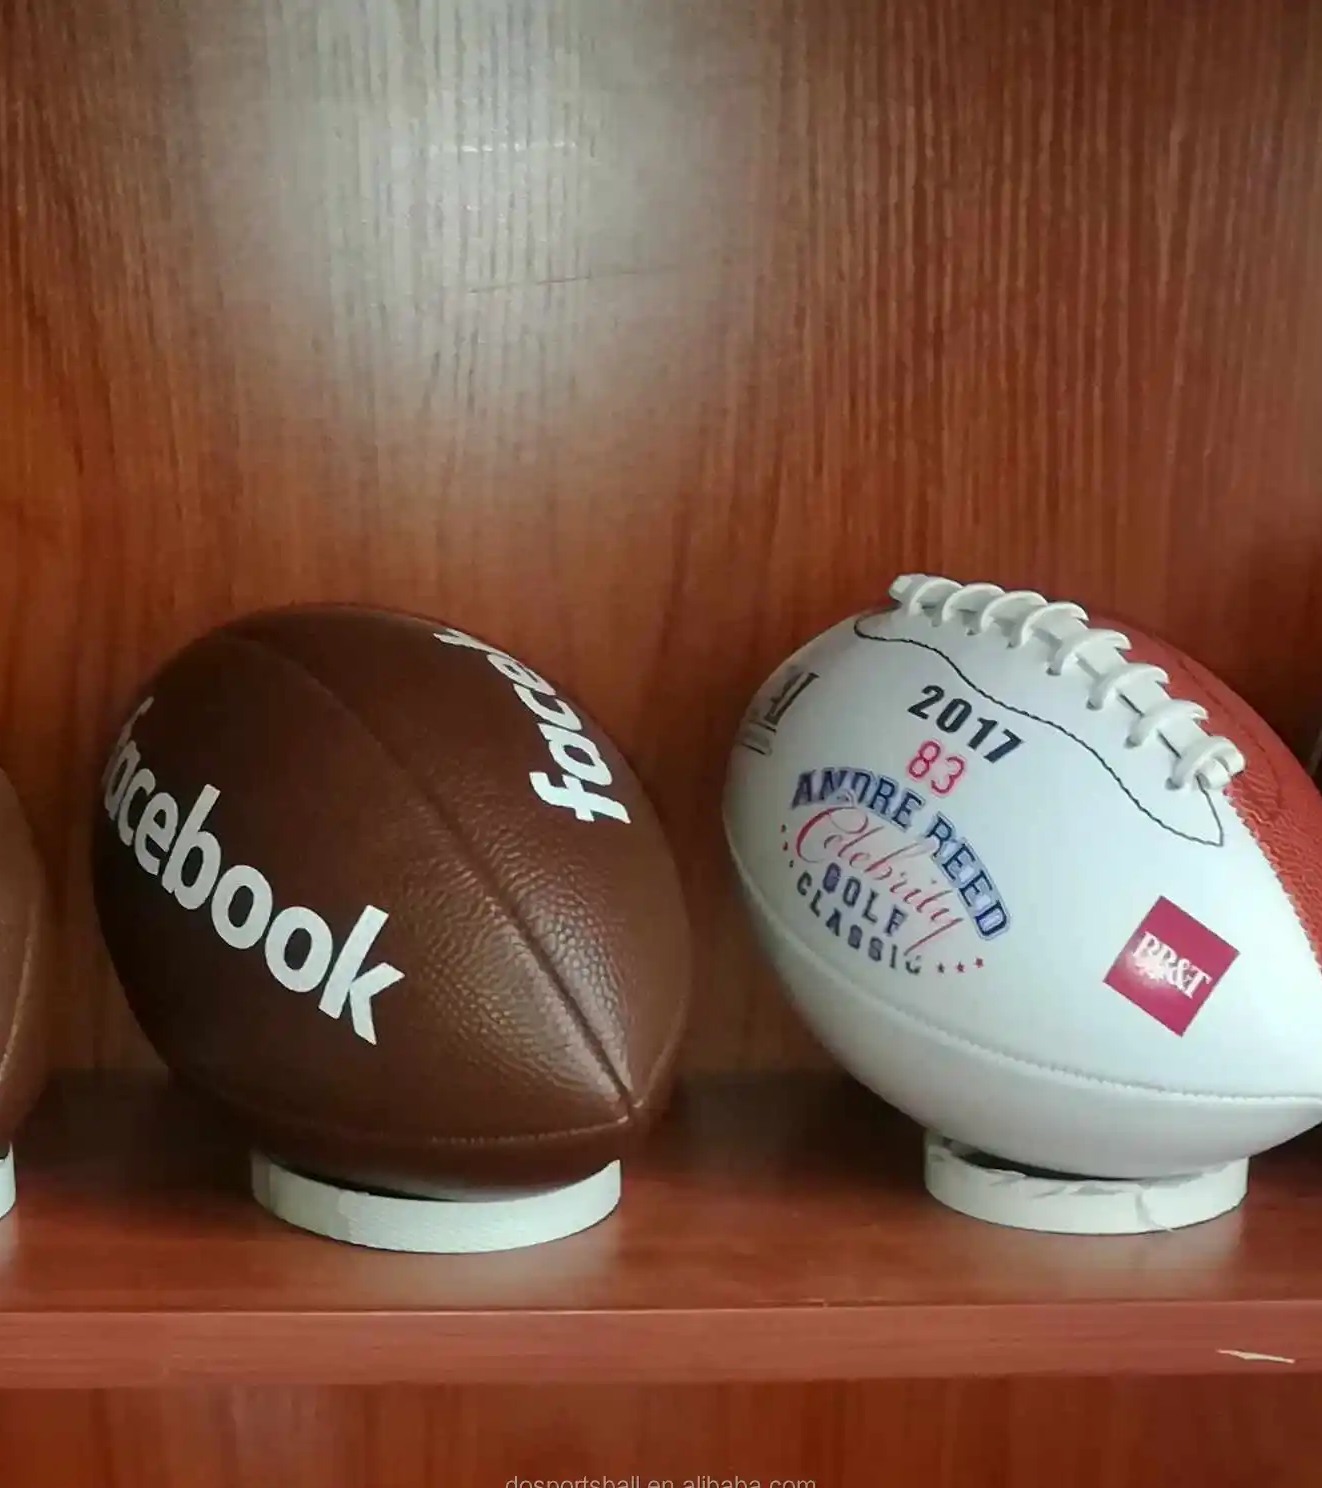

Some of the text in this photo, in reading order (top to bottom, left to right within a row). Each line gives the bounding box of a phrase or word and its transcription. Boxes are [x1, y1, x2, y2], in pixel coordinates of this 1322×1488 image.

[907, 684, 1024, 764] 2017
[907, 739, 966, 796] 83
[790, 766, 1011, 941] ANDRE REED
[822, 861, 908, 938] GOLF
